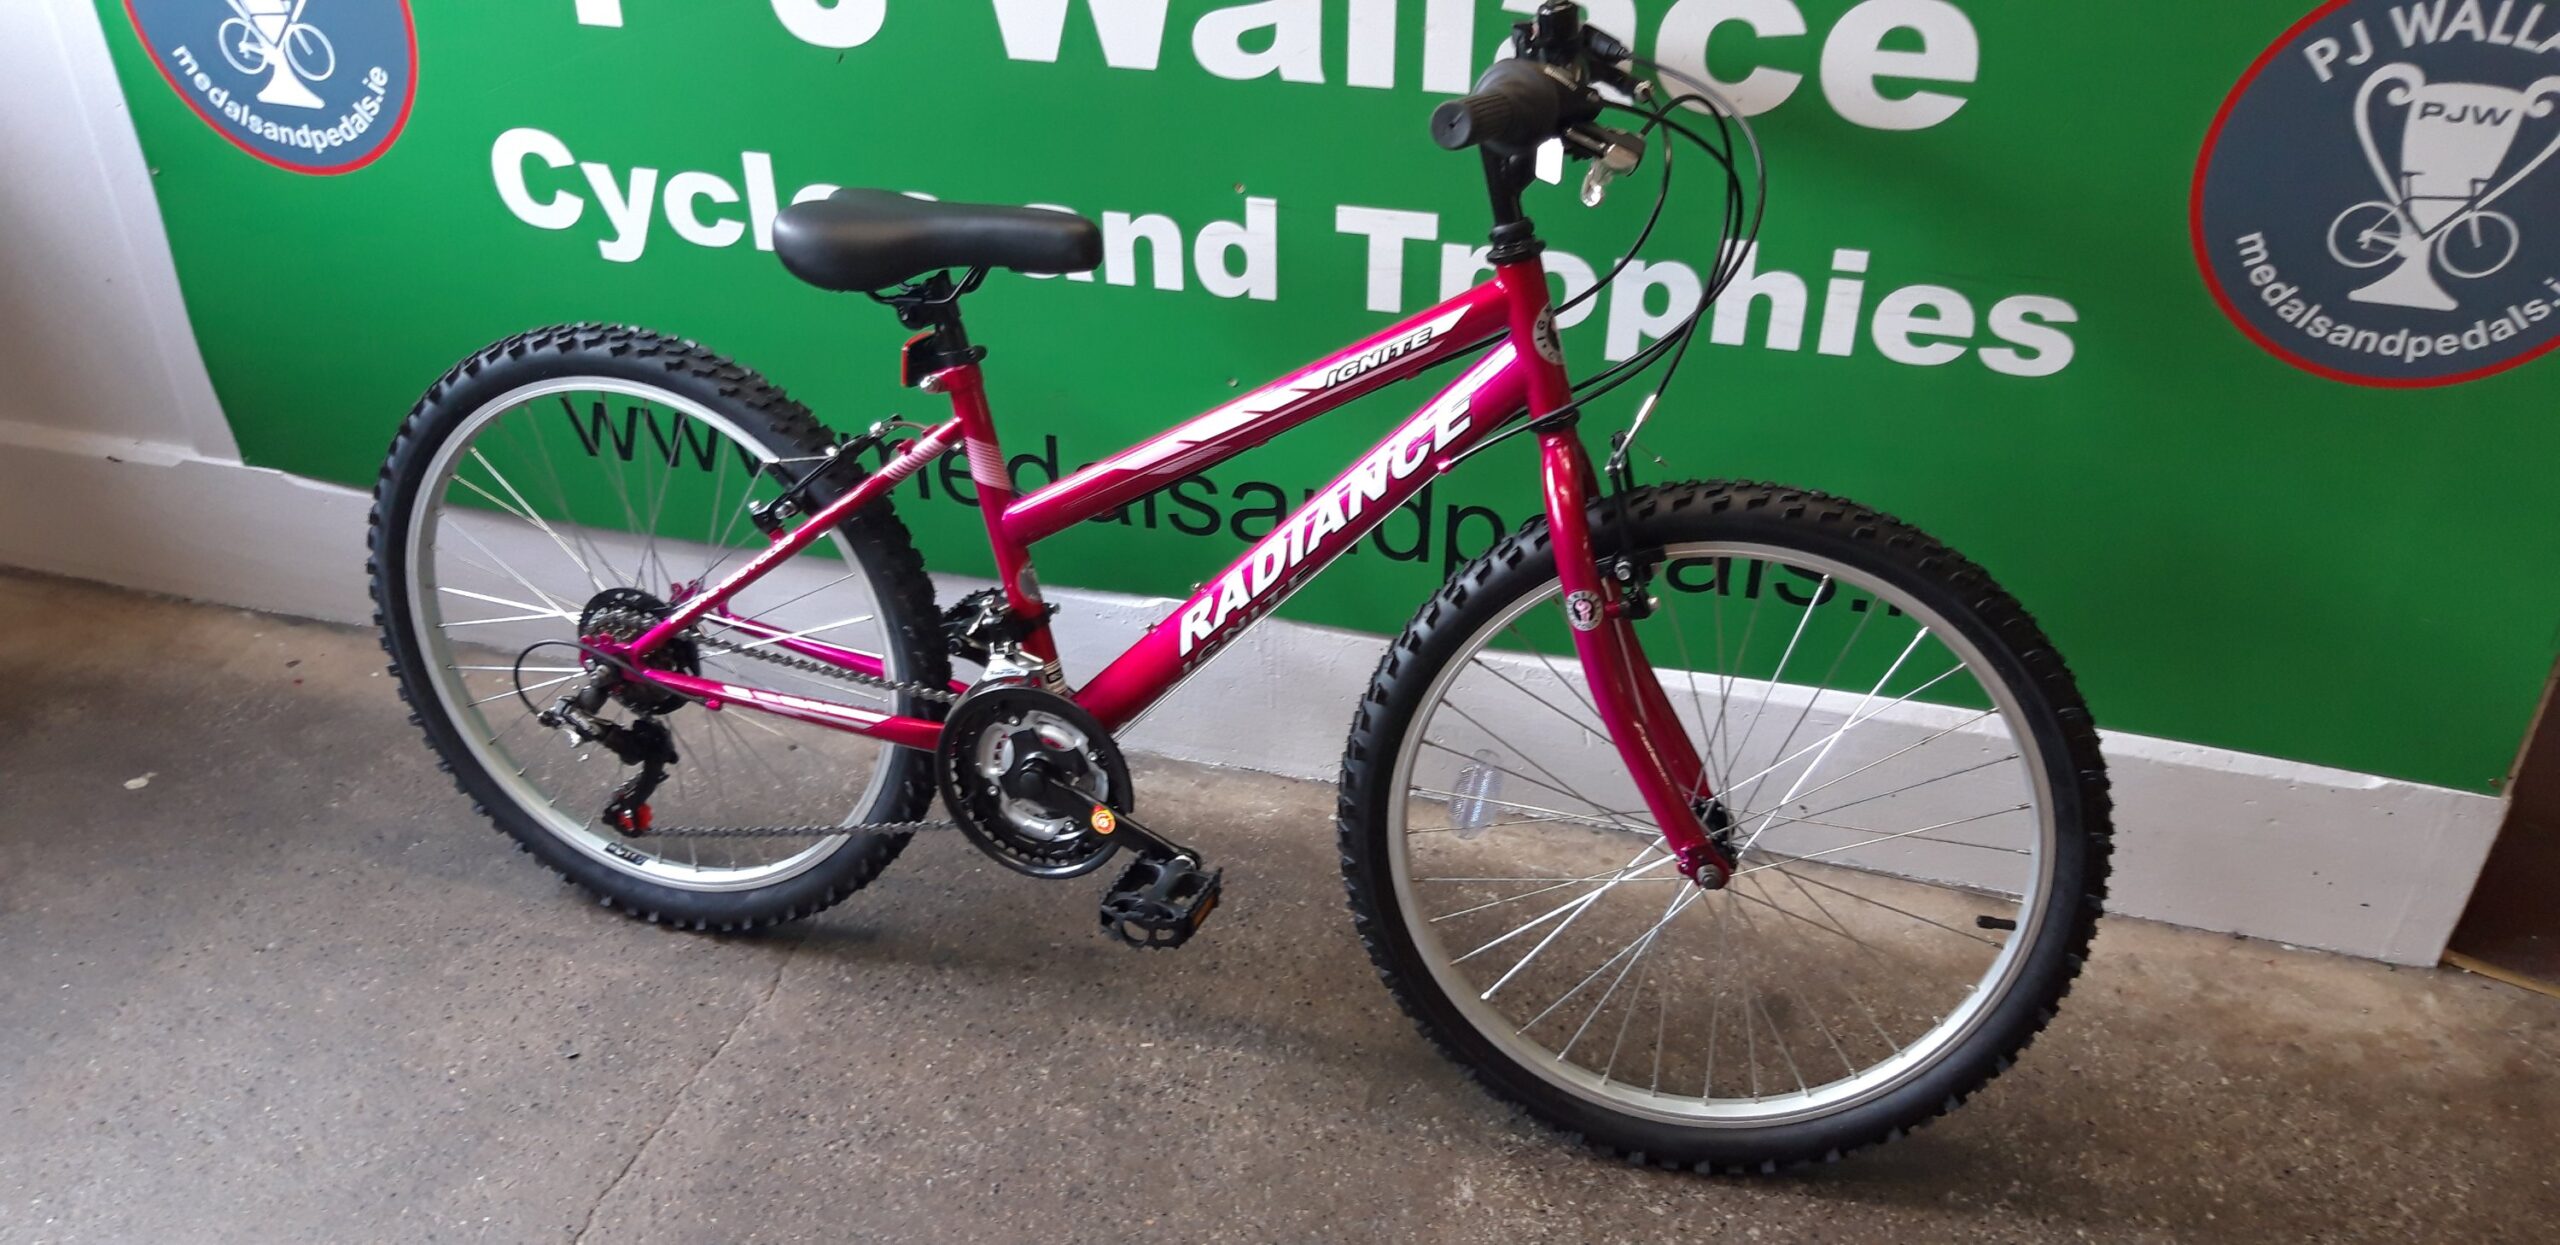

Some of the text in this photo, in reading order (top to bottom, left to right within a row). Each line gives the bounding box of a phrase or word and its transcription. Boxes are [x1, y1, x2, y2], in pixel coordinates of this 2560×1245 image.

[2303, 20, 2374, 83] PJ
[172, 45, 389, 154] medalsandpedals.ie
[2419, 102, 2513, 127] PJW
[491, 127, 939, 262] Cycl
[1022, 198, 1277, 301] nd
[1335, 205, 2079, 377] Trophies
[1326, 327, 1433, 388] IGNITE
[1179, 392, 1473, 658] RADIANCE
